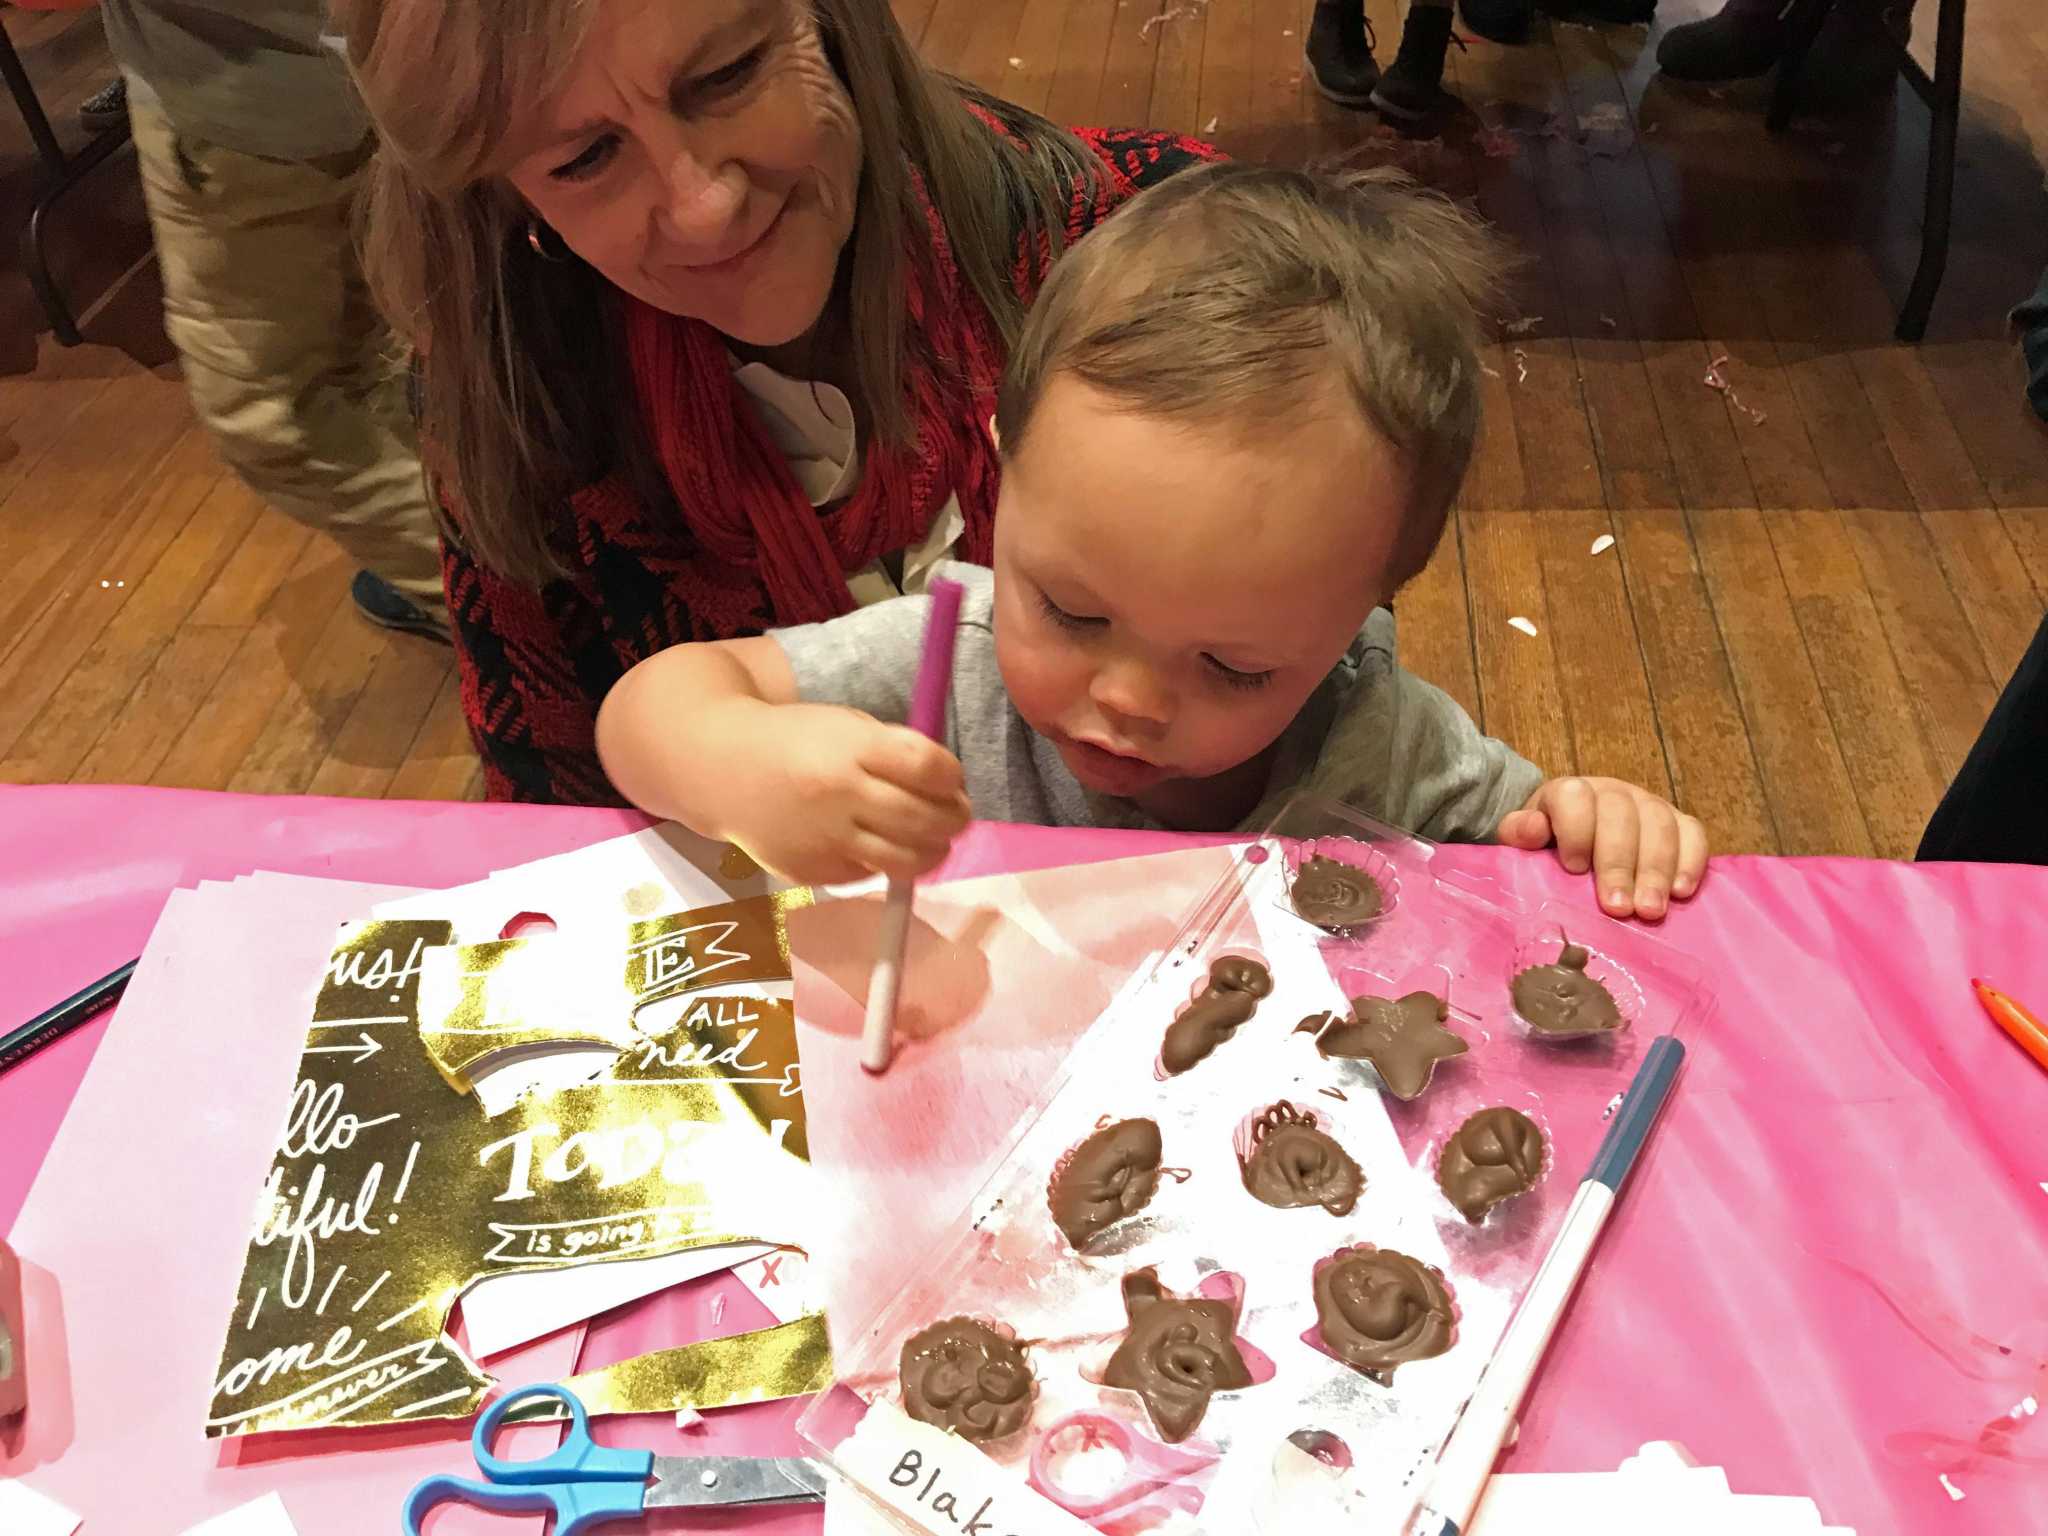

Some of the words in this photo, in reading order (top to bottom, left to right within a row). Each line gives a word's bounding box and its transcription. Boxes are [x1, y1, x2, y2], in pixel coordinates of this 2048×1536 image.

[686, 1001, 760, 1032] ALL
[637, 1028, 768, 1071] need
[526, 1229, 552, 1254] is
[559, 1222, 645, 1257] going
[888, 1449, 1019, 1536] Blak
